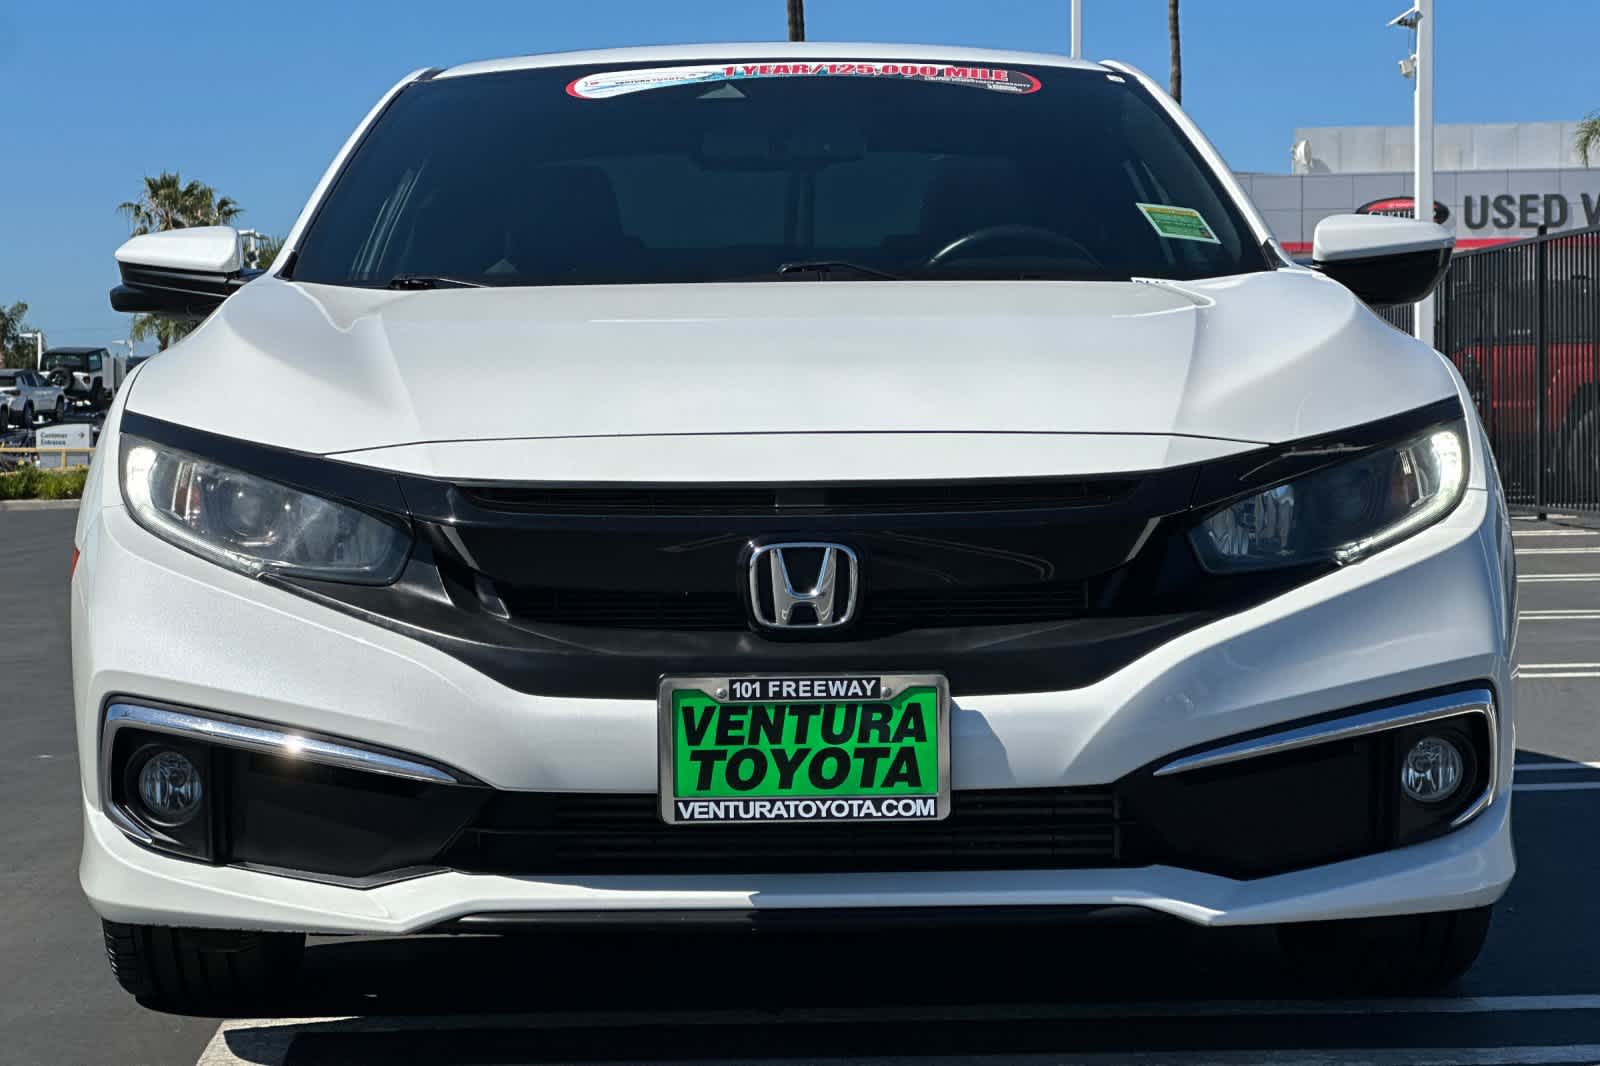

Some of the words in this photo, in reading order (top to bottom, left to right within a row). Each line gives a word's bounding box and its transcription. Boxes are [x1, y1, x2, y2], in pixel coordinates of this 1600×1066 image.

[722, 65, 737, 77] 1
[743, 64, 938, 78] YEAR/125,000
[944, 66, 1009, 82] MILE
[1464, 193, 1569, 230] USED
[732, 680, 761, 698] 101
[768, 679, 877, 698] FREEWAY
[681, 702, 928, 746] VENTURA
[689, 746, 923, 792] TOYOTA
[677, 799, 935, 820] VENTURATOYOTA.COM
